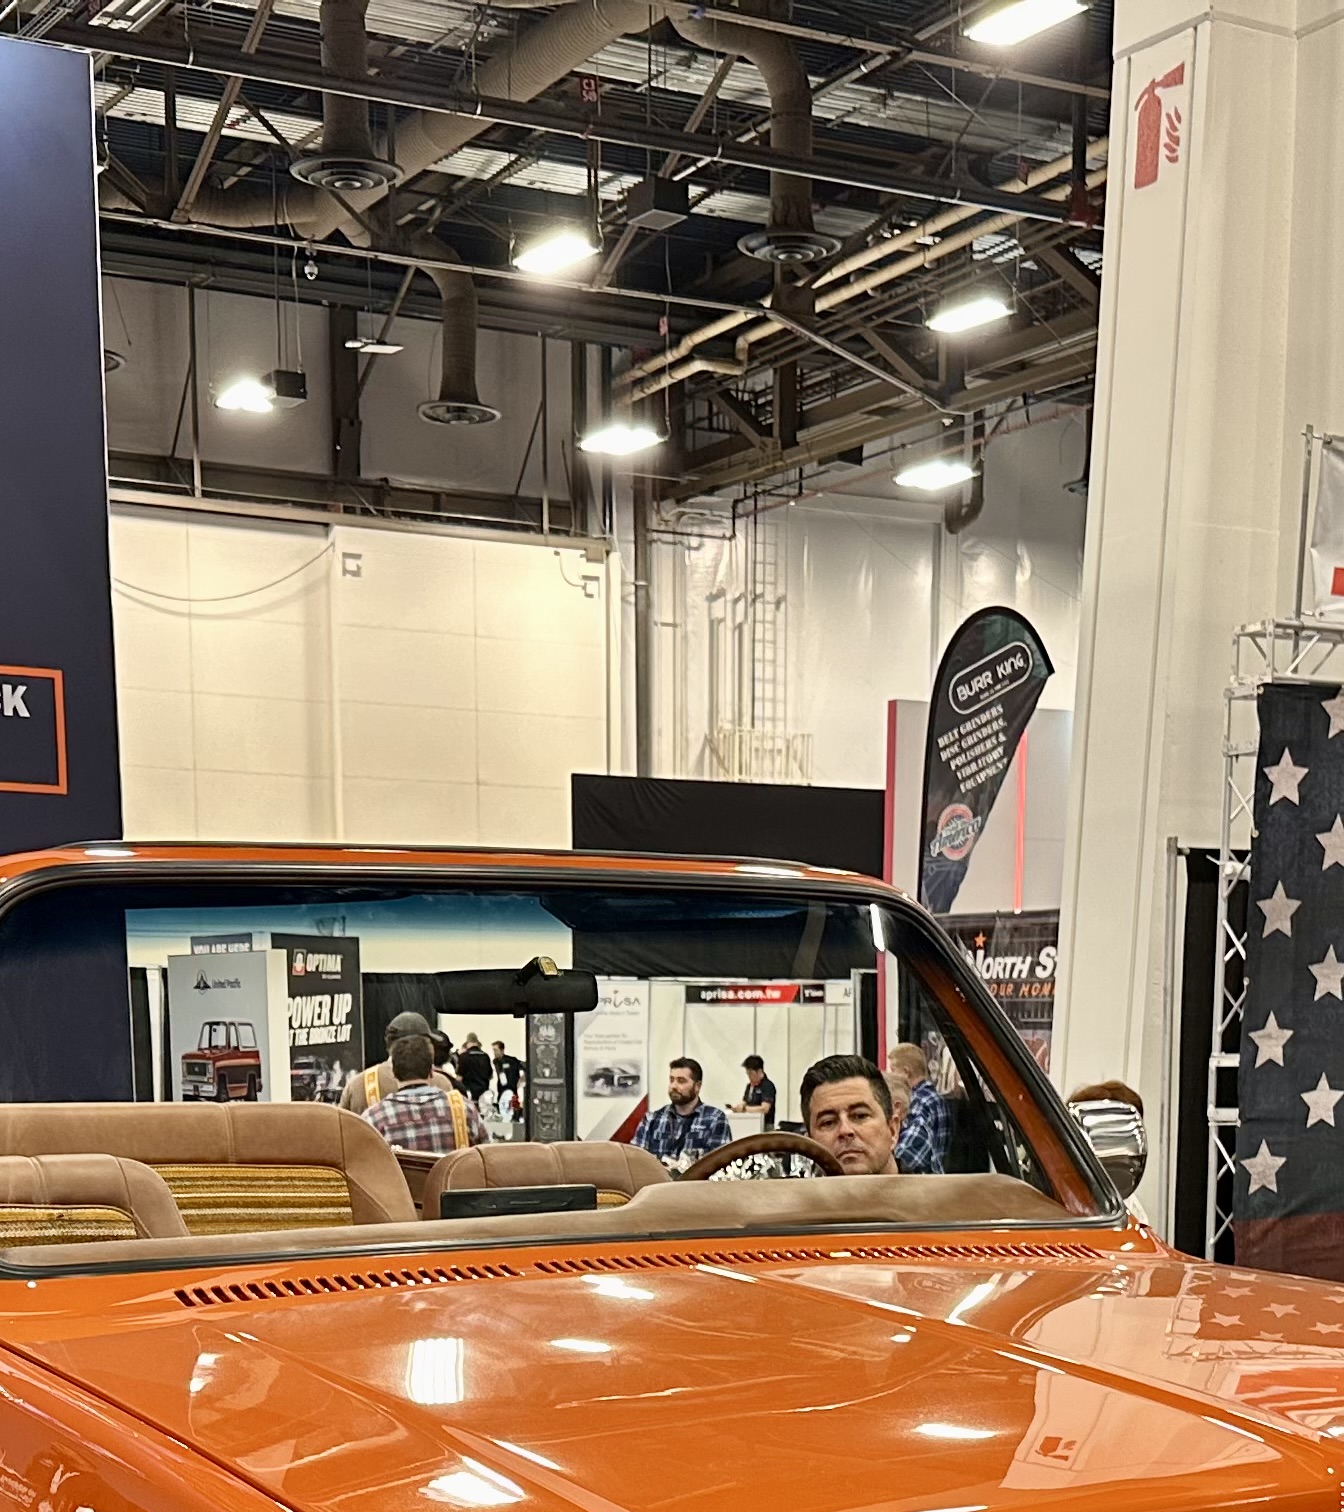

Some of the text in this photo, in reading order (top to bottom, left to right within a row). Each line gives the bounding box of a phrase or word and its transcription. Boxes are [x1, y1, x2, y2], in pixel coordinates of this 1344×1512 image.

[956, 671, 993, 702] BURR
[996, 652, 1024, 679] KING
[306, 953, 343, 972] OPTIMA
[700, 988, 781, 1001] aprisa.com.tw
[288, 993, 352, 1029] POWER UP
